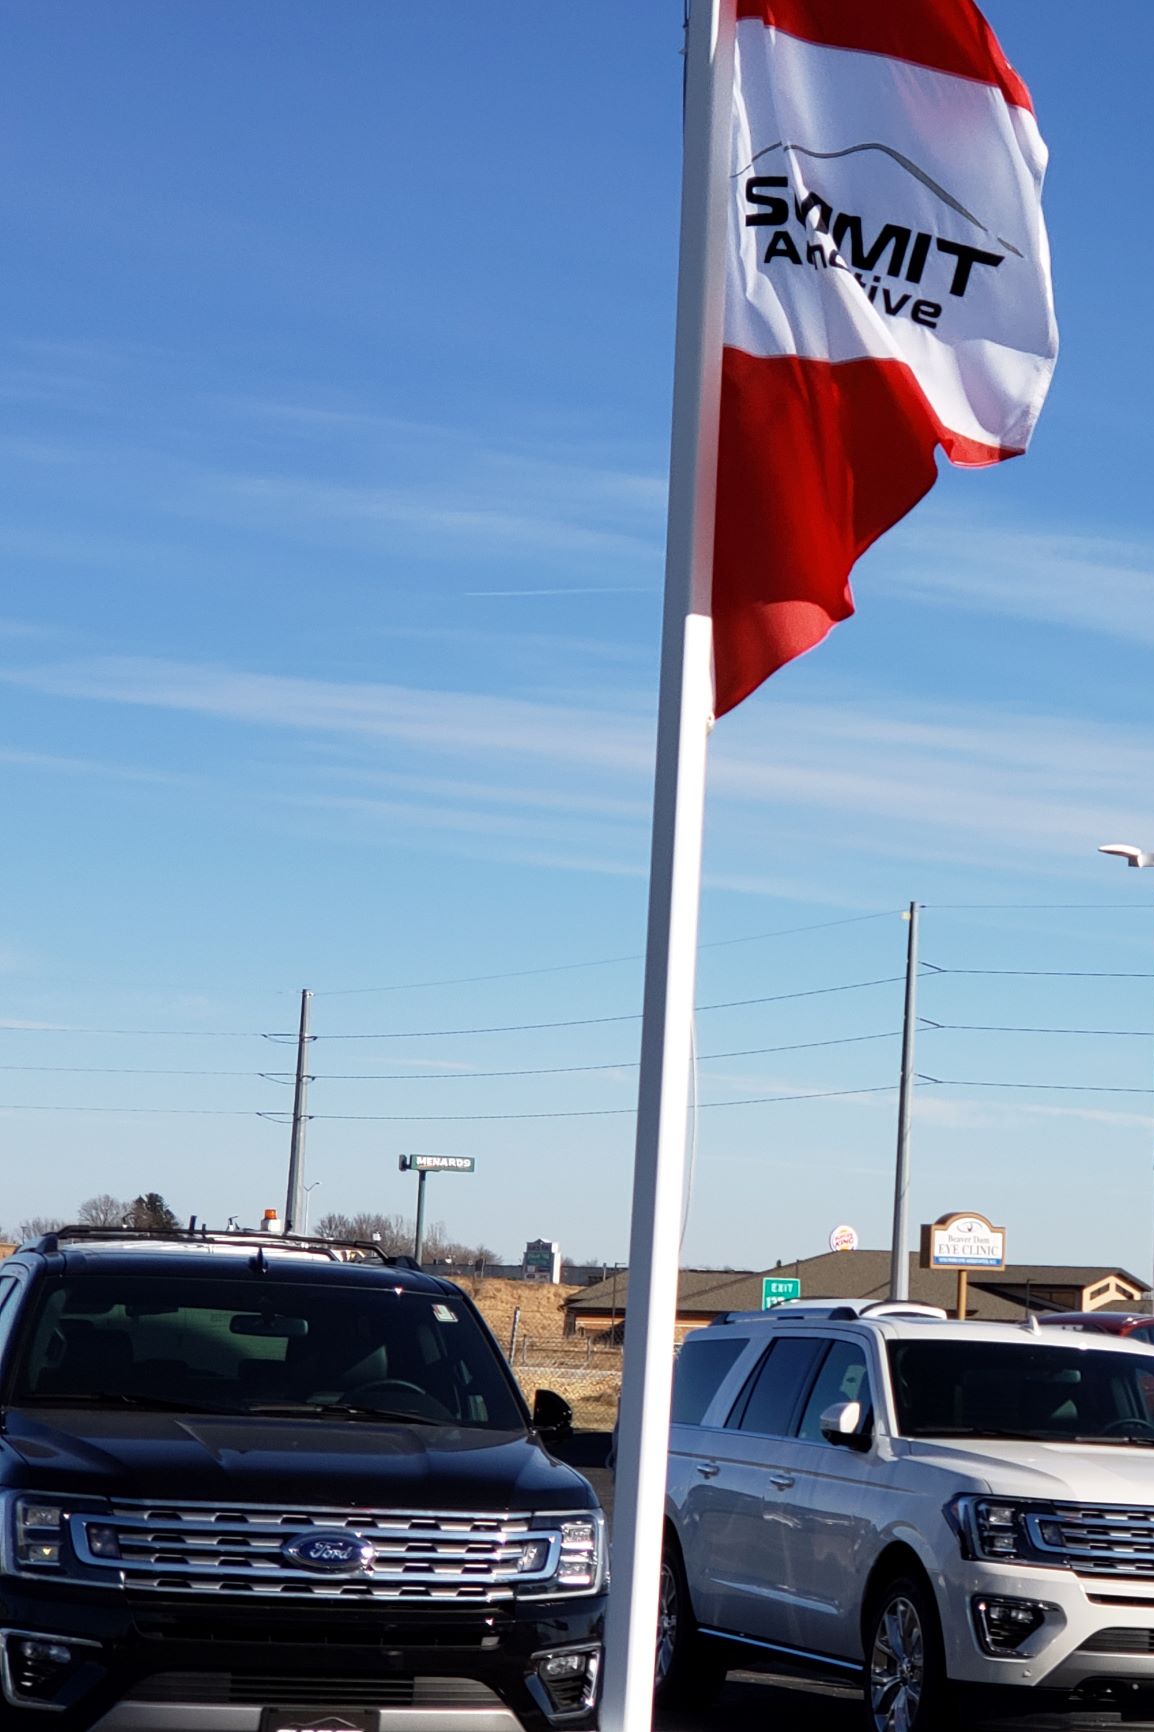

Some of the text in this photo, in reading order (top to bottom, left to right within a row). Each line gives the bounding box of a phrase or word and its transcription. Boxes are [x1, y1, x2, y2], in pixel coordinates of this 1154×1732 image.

[745, 176, 1005, 297] SMIT
[416, 1156, 471, 1168] MENARDS
[948, 1234, 990, 1245] Beaver Dam
[938, 1243, 999, 1256] EYE CLINIC
[771, 1282, 793, 1292] EXIT
[309, 1541, 352, 1560] Ford
